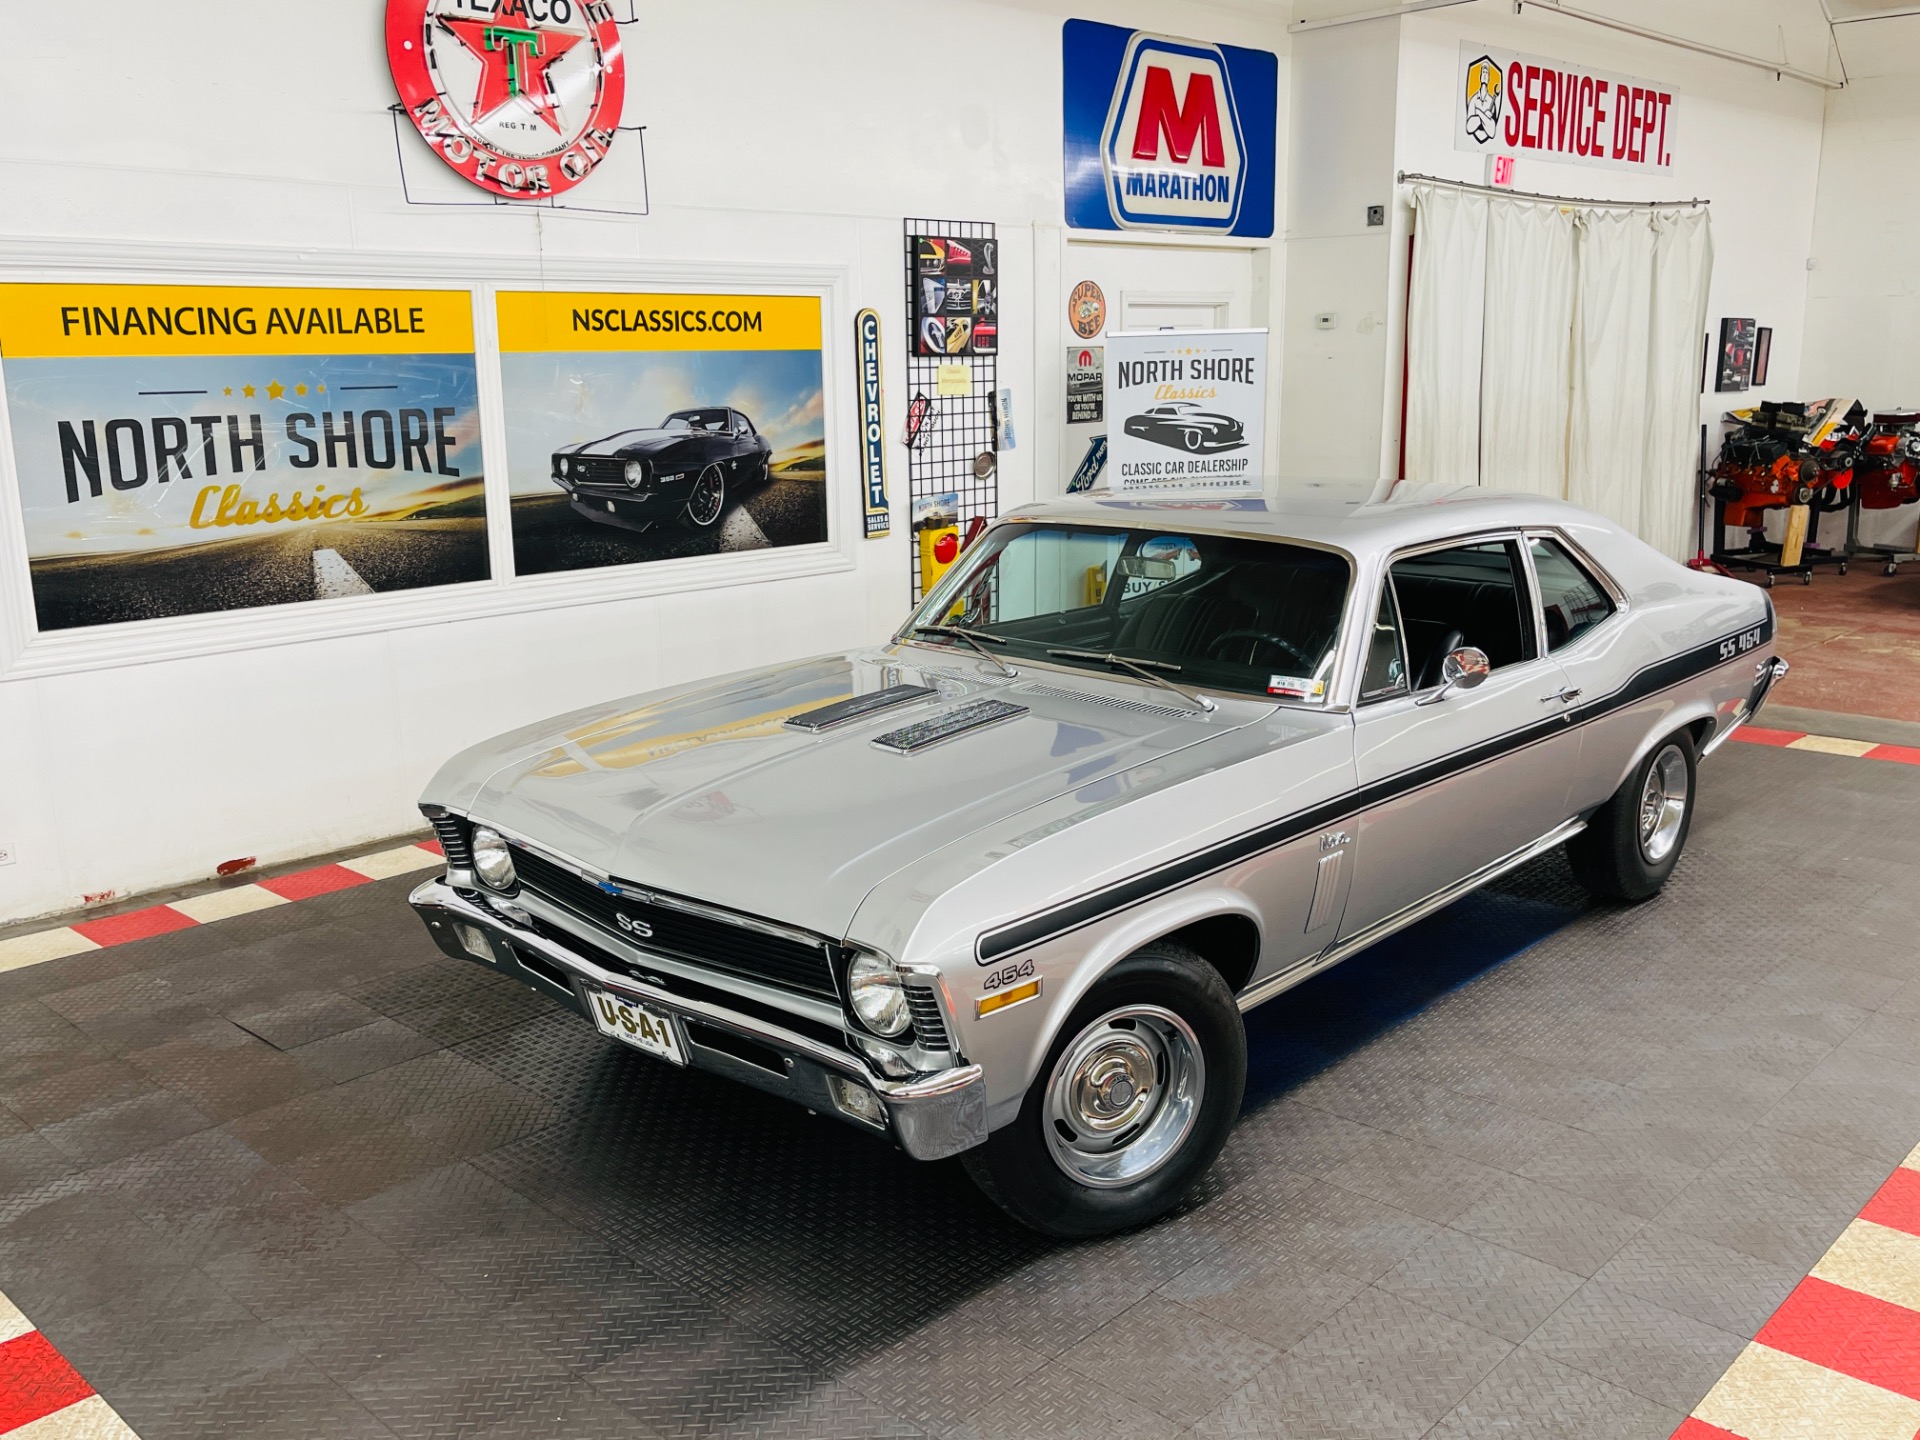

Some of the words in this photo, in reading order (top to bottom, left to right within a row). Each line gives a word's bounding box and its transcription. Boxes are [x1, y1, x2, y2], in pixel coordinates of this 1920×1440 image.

[499, 121, 516, 129] REG
[1504, 61, 1608, 158] SERVICE
[1612, 84, 1671, 167] DEPT.
[412, 97, 552, 196] MOTOR
[1494, 156, 1515, 185] EXIT
[1126, 168, 1230, 203] MARATHON
[1072, 283, 1102, 314] SUPER
[60, 306, 257, 336] FINANCING
[266, 306, 425, 335] AVAILABLE
[572, 309, 763, 332] NSCLASSICS.COM
[1077, 314, 1101, 336] BEE
[1068, 372, 1103, 382] MOPAR
[1118, 360, 1183, 389] NORTH
[1190, 357, 1255, 385] SHORE
[1083, 393, 1096, 402] WITH
[1097, 393, 1103, 401] US
[1154, 384, 1217, 401] Classics
[863, 319, 882, 505] CHEVROLET
[57, 413, 266, 504] NORTH
[285, 406, 460, 477] SHORE
[1121, 463, 1162, 477] CLASSIC
[1165, 461, 1184, 475] CAR
[1187, 458, 1249, 474] DEALERSHIP
[1075, 455, 1099, 492] Ford
[189, 483, 370, 530] Classics
[867, 515, 883, 523] SALES
[867, 521, 889, 530] SERVICE
[1124, 581, 1151, 594] BUY
[1719, 638, 1736, 661] SS
[1738, 627, 1760, 651] 454
[615, 912, 653, 938] SS
[984, 958, 1035, 990] 454
